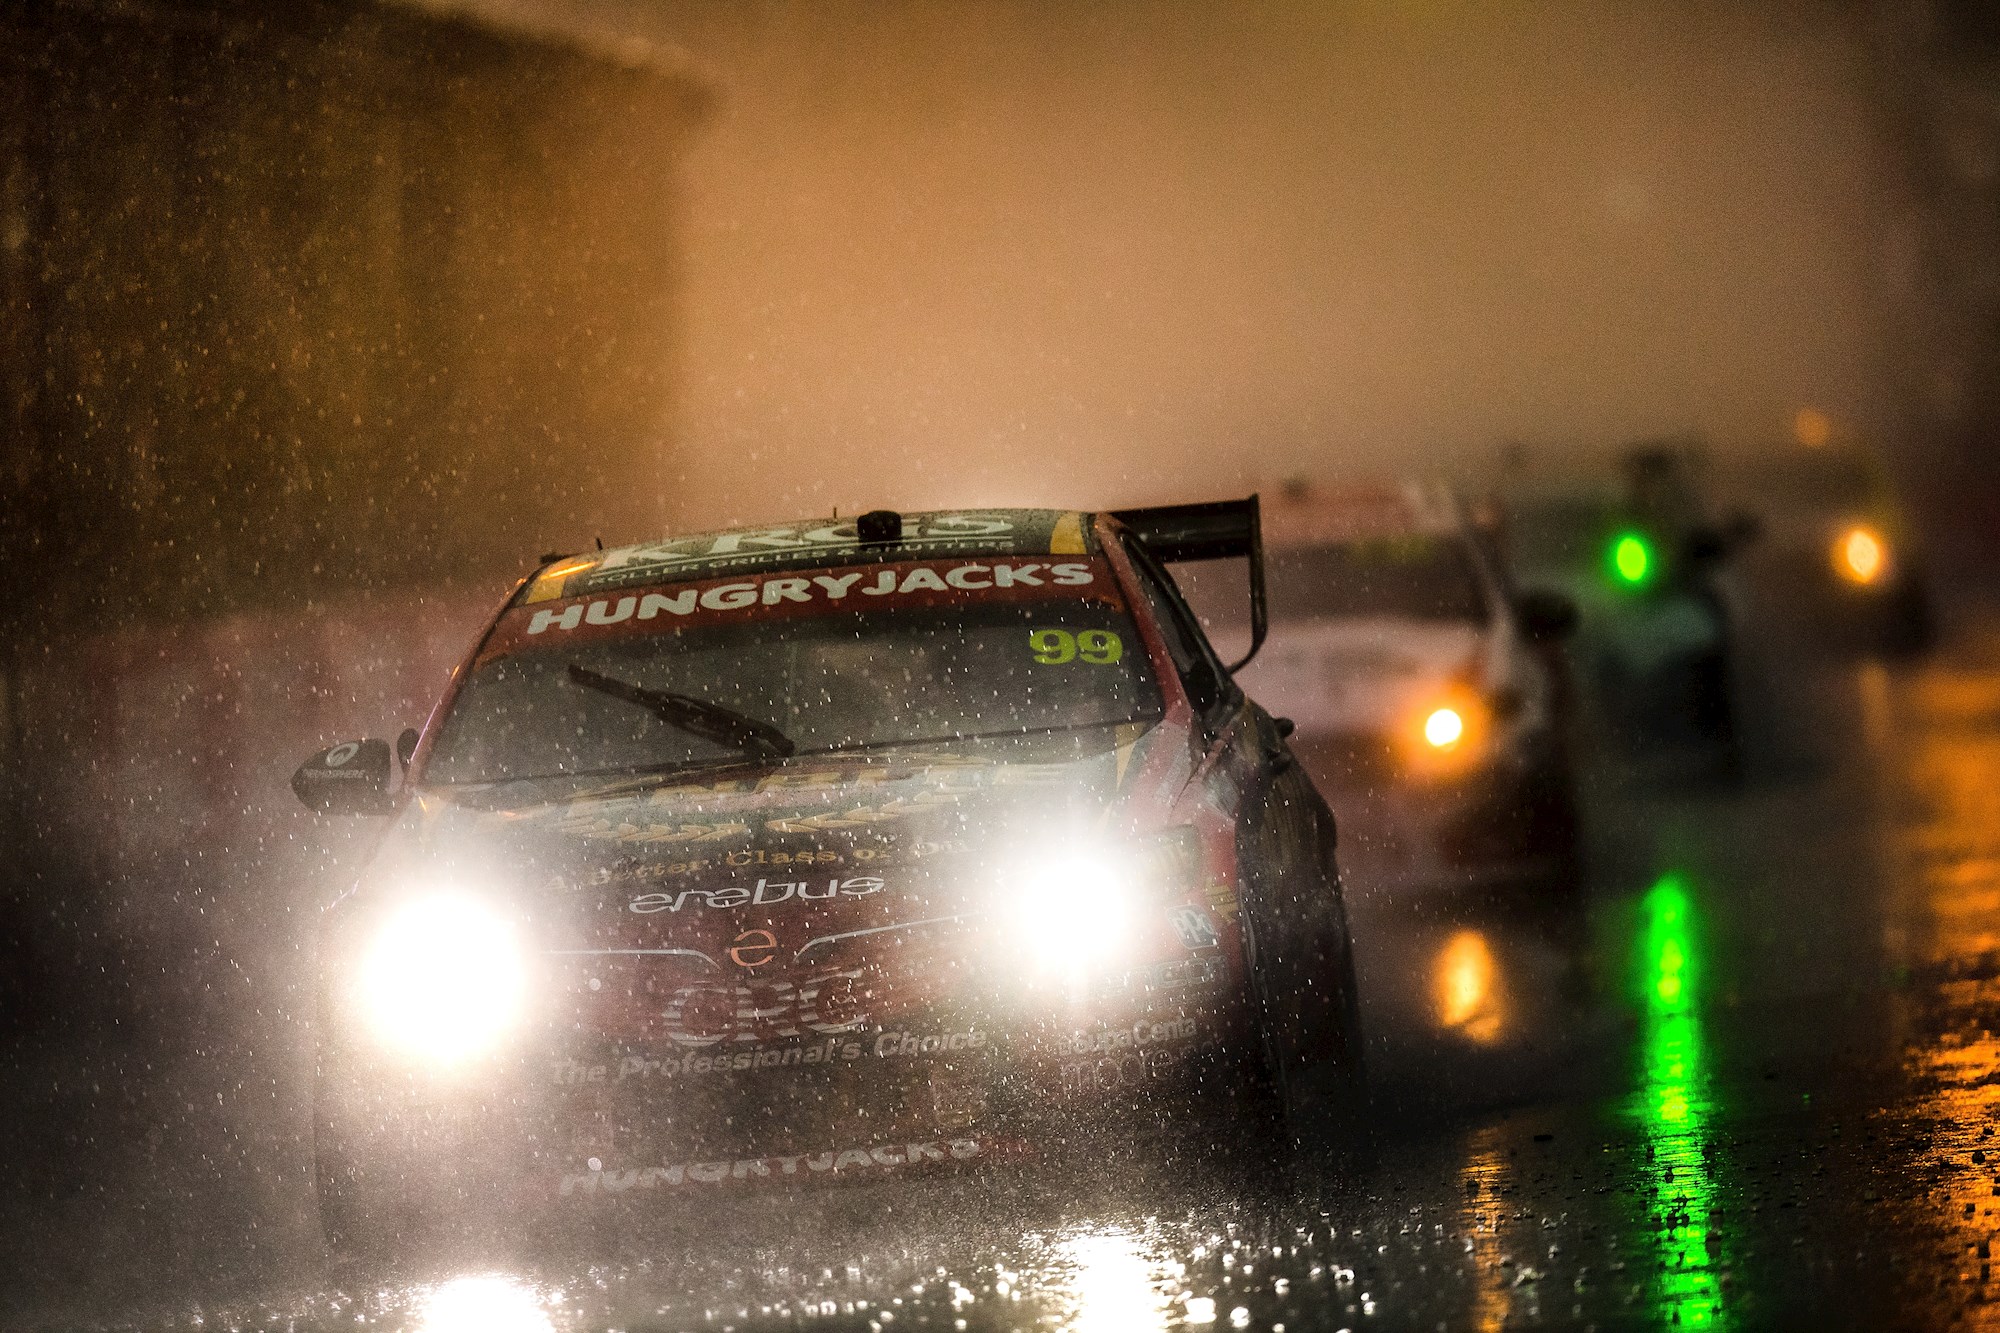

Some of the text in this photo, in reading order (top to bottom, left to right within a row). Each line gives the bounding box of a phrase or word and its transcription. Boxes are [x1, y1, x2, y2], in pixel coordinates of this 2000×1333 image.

[1029, 628, 1123, 665] 99
[726, 847, 837, 869] Class
[628, 875, 885, 915] erebus
[551, 1026, 987, 1086] The Professional's Choice
